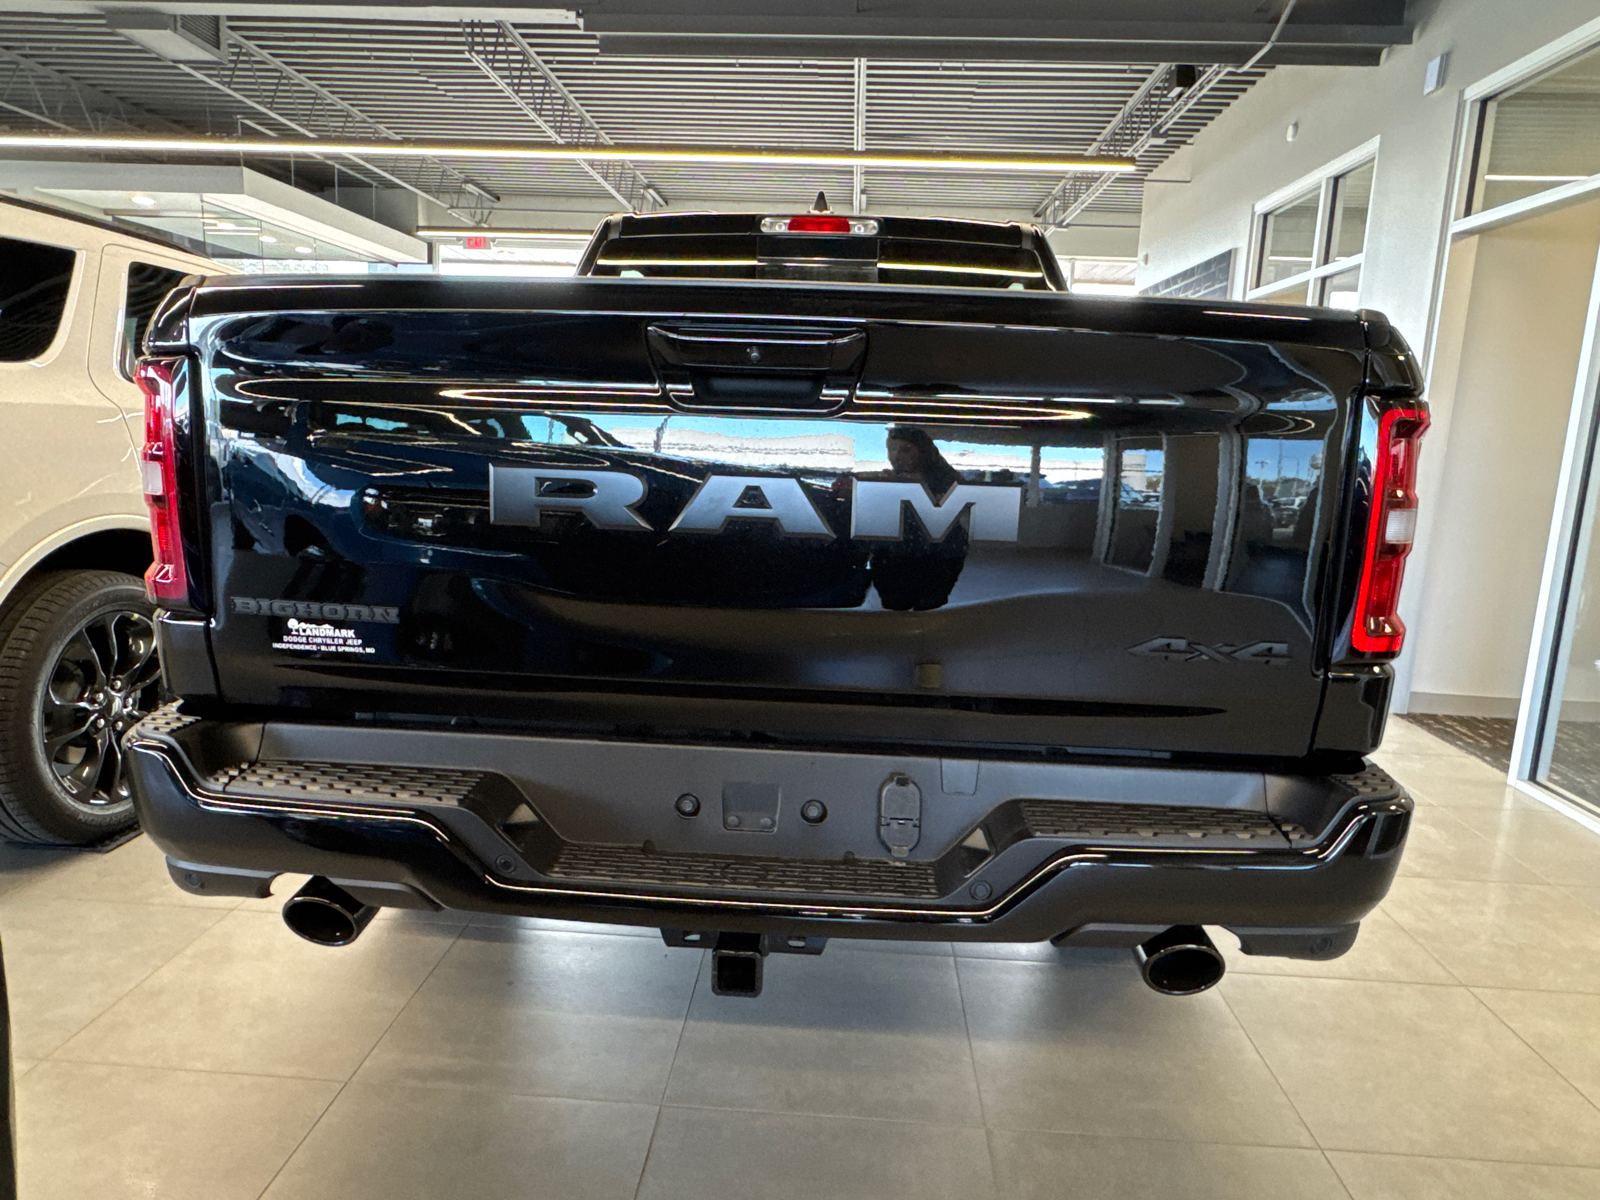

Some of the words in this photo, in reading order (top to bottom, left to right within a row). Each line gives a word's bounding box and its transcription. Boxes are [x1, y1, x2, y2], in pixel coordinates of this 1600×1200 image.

[489, 463, 1024, 542] RAM
[231, 597, 400, 624] BIGHORN
[299, 627, 356, 638] LANDMARK
[283, 635, 307, 643] DODGE
[308, 637, 344, 645] CHRYSLER
[345, 638, 363, 646] JEEP
[272, 642, 317, 651] INDEPENDENCE
